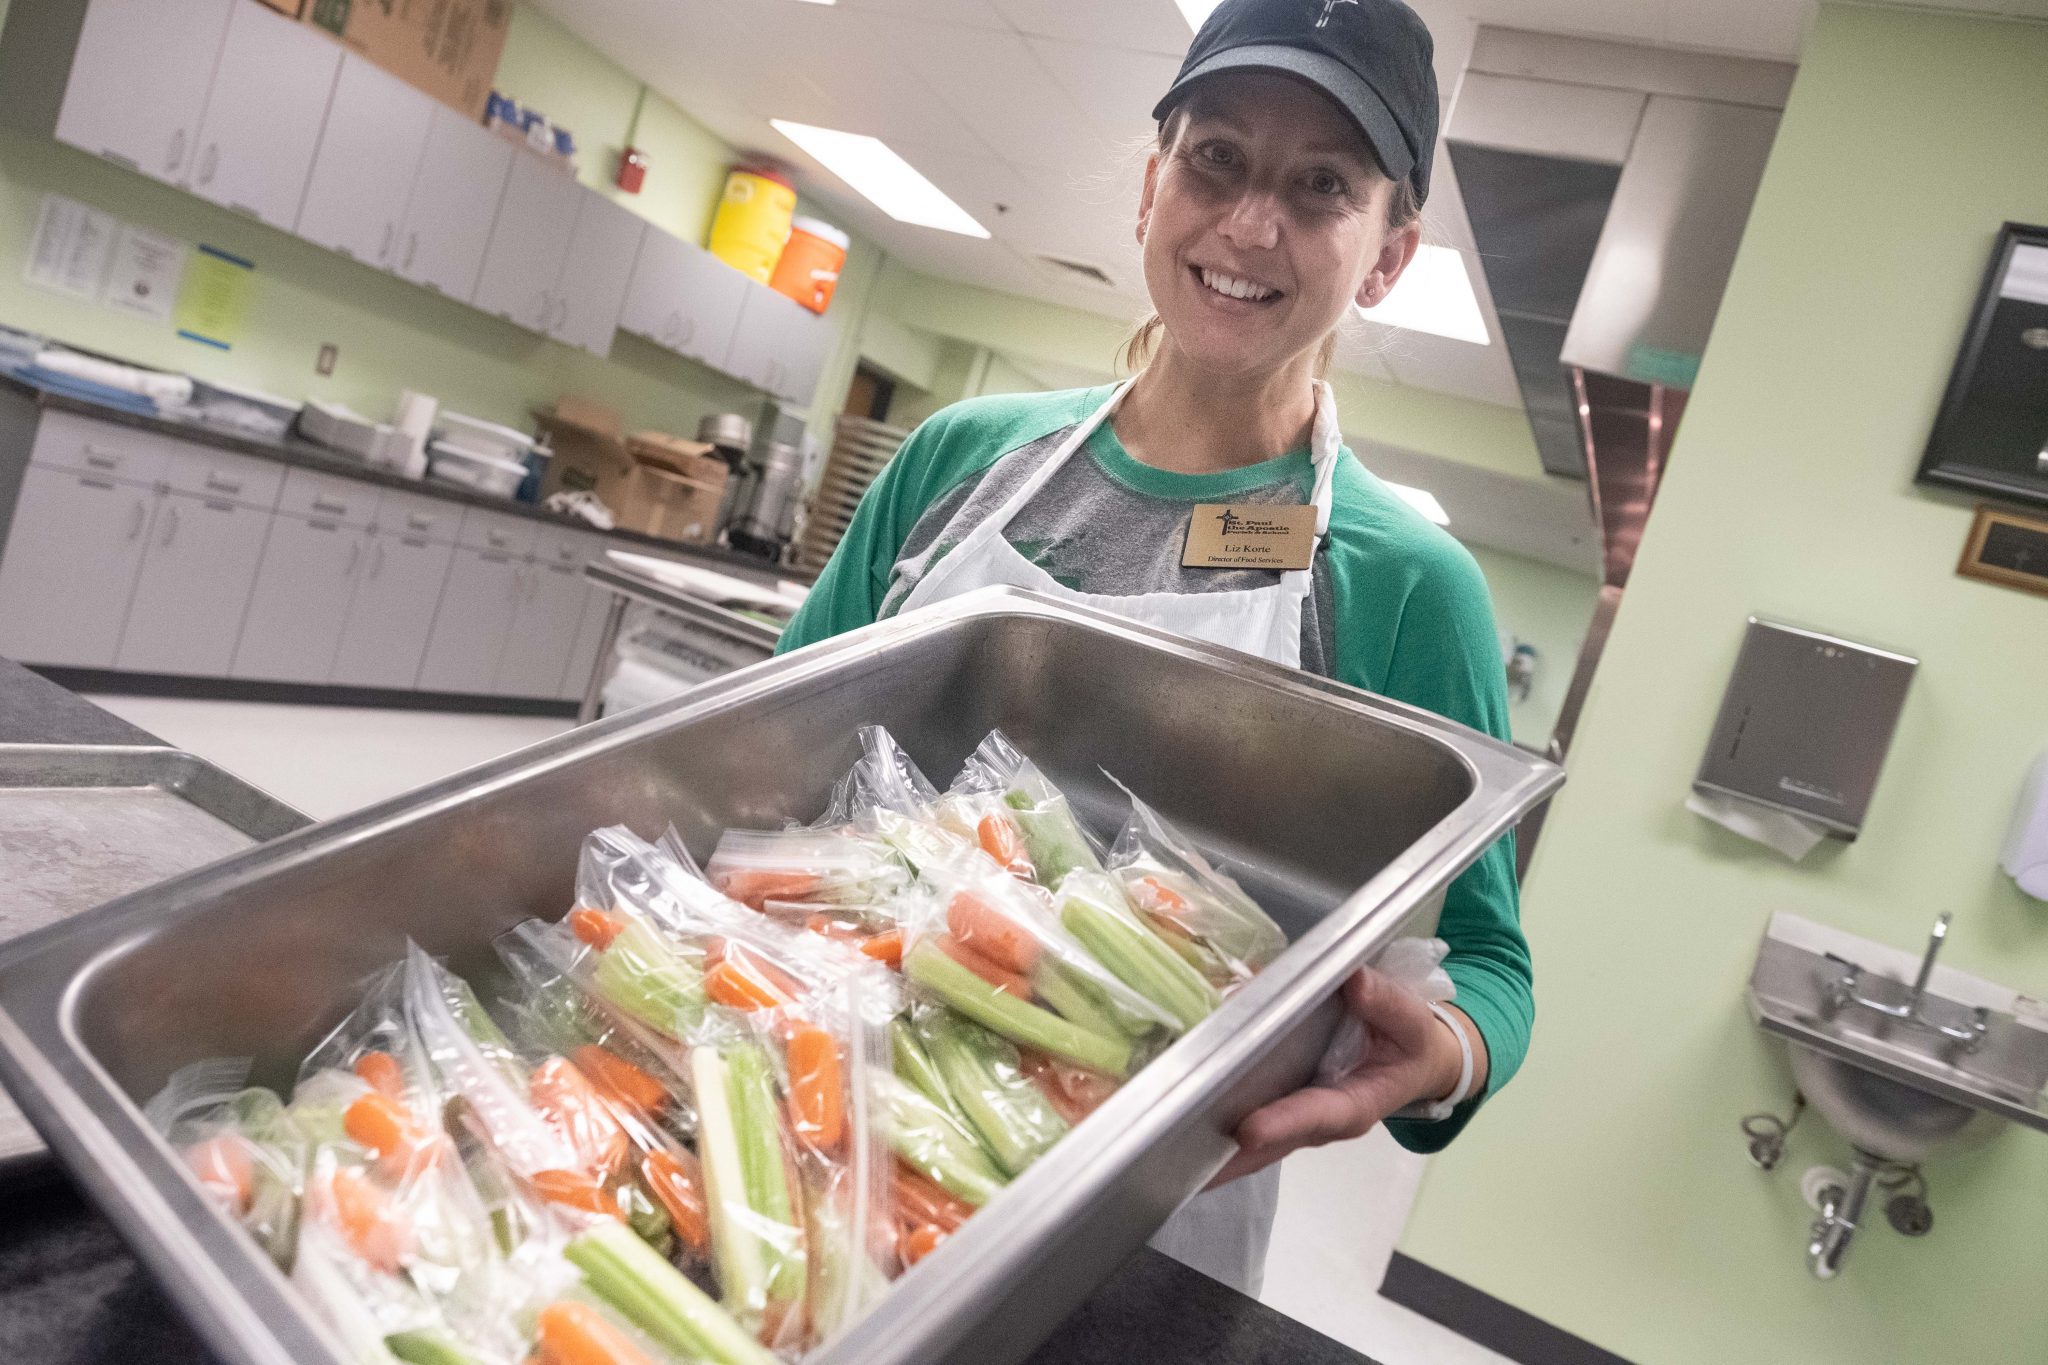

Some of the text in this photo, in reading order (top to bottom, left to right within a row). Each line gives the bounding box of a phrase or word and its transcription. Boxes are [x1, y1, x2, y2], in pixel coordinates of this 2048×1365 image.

[1225, 544, 1272, 553] Liz Korte
[1207, 555, 1233, 563] Director
[1257, 556, 1284, 564] Services
